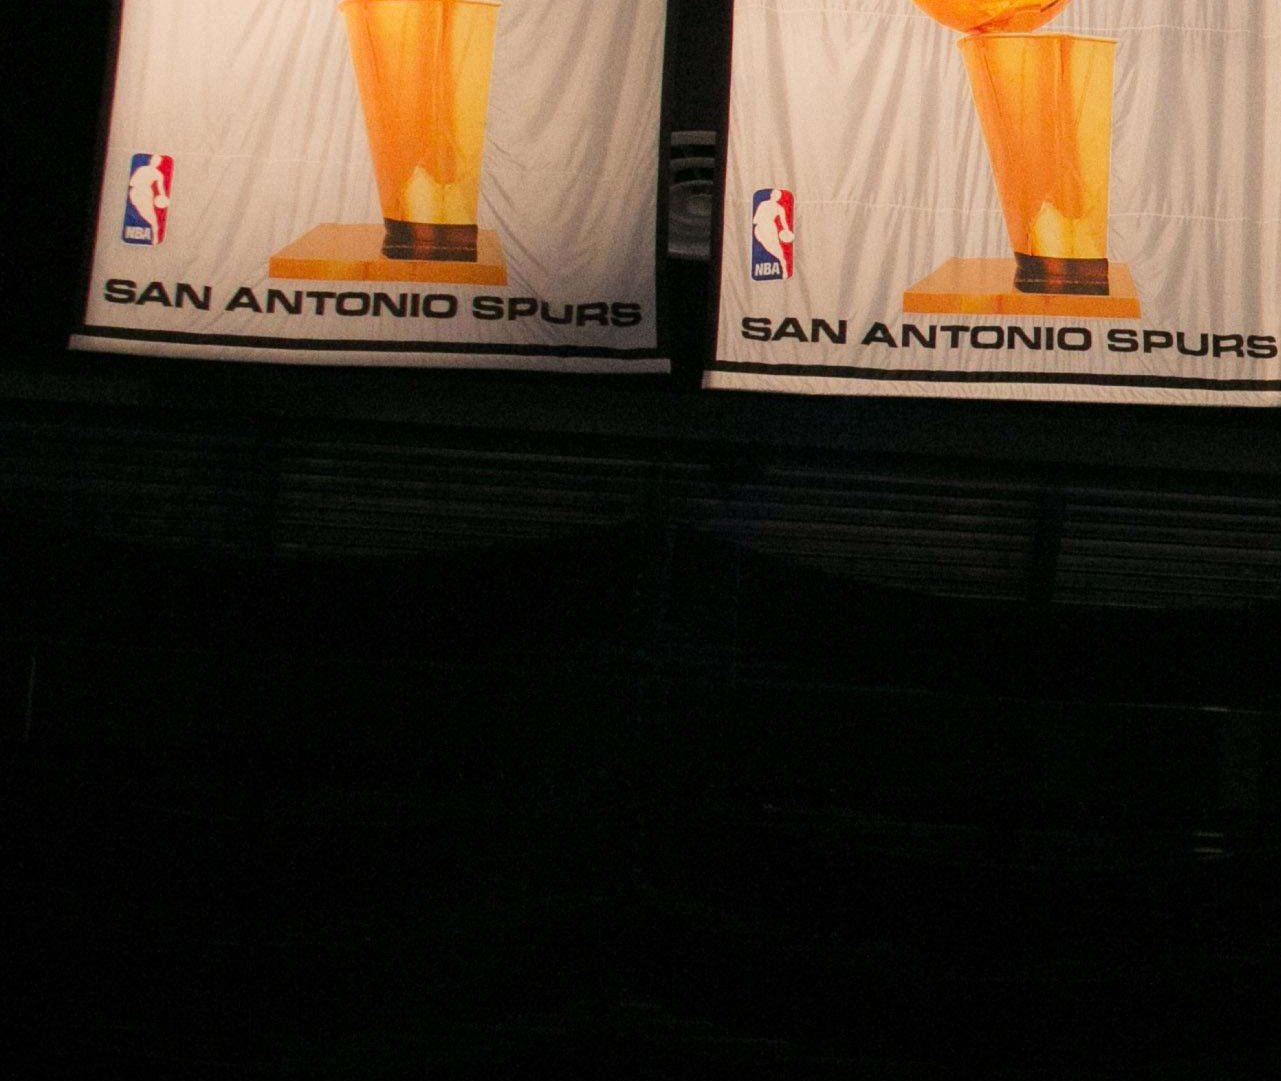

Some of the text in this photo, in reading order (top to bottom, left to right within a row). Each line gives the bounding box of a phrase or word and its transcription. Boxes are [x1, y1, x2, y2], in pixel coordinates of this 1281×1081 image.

[125, 226, 152, 241] NBA
[754, 262, 781, 278] NBA
[104, 278, 642, 328] SAN ANTONIO SPURS
[741, 317, 1278, 359] SAN ANTONIO SPURS
